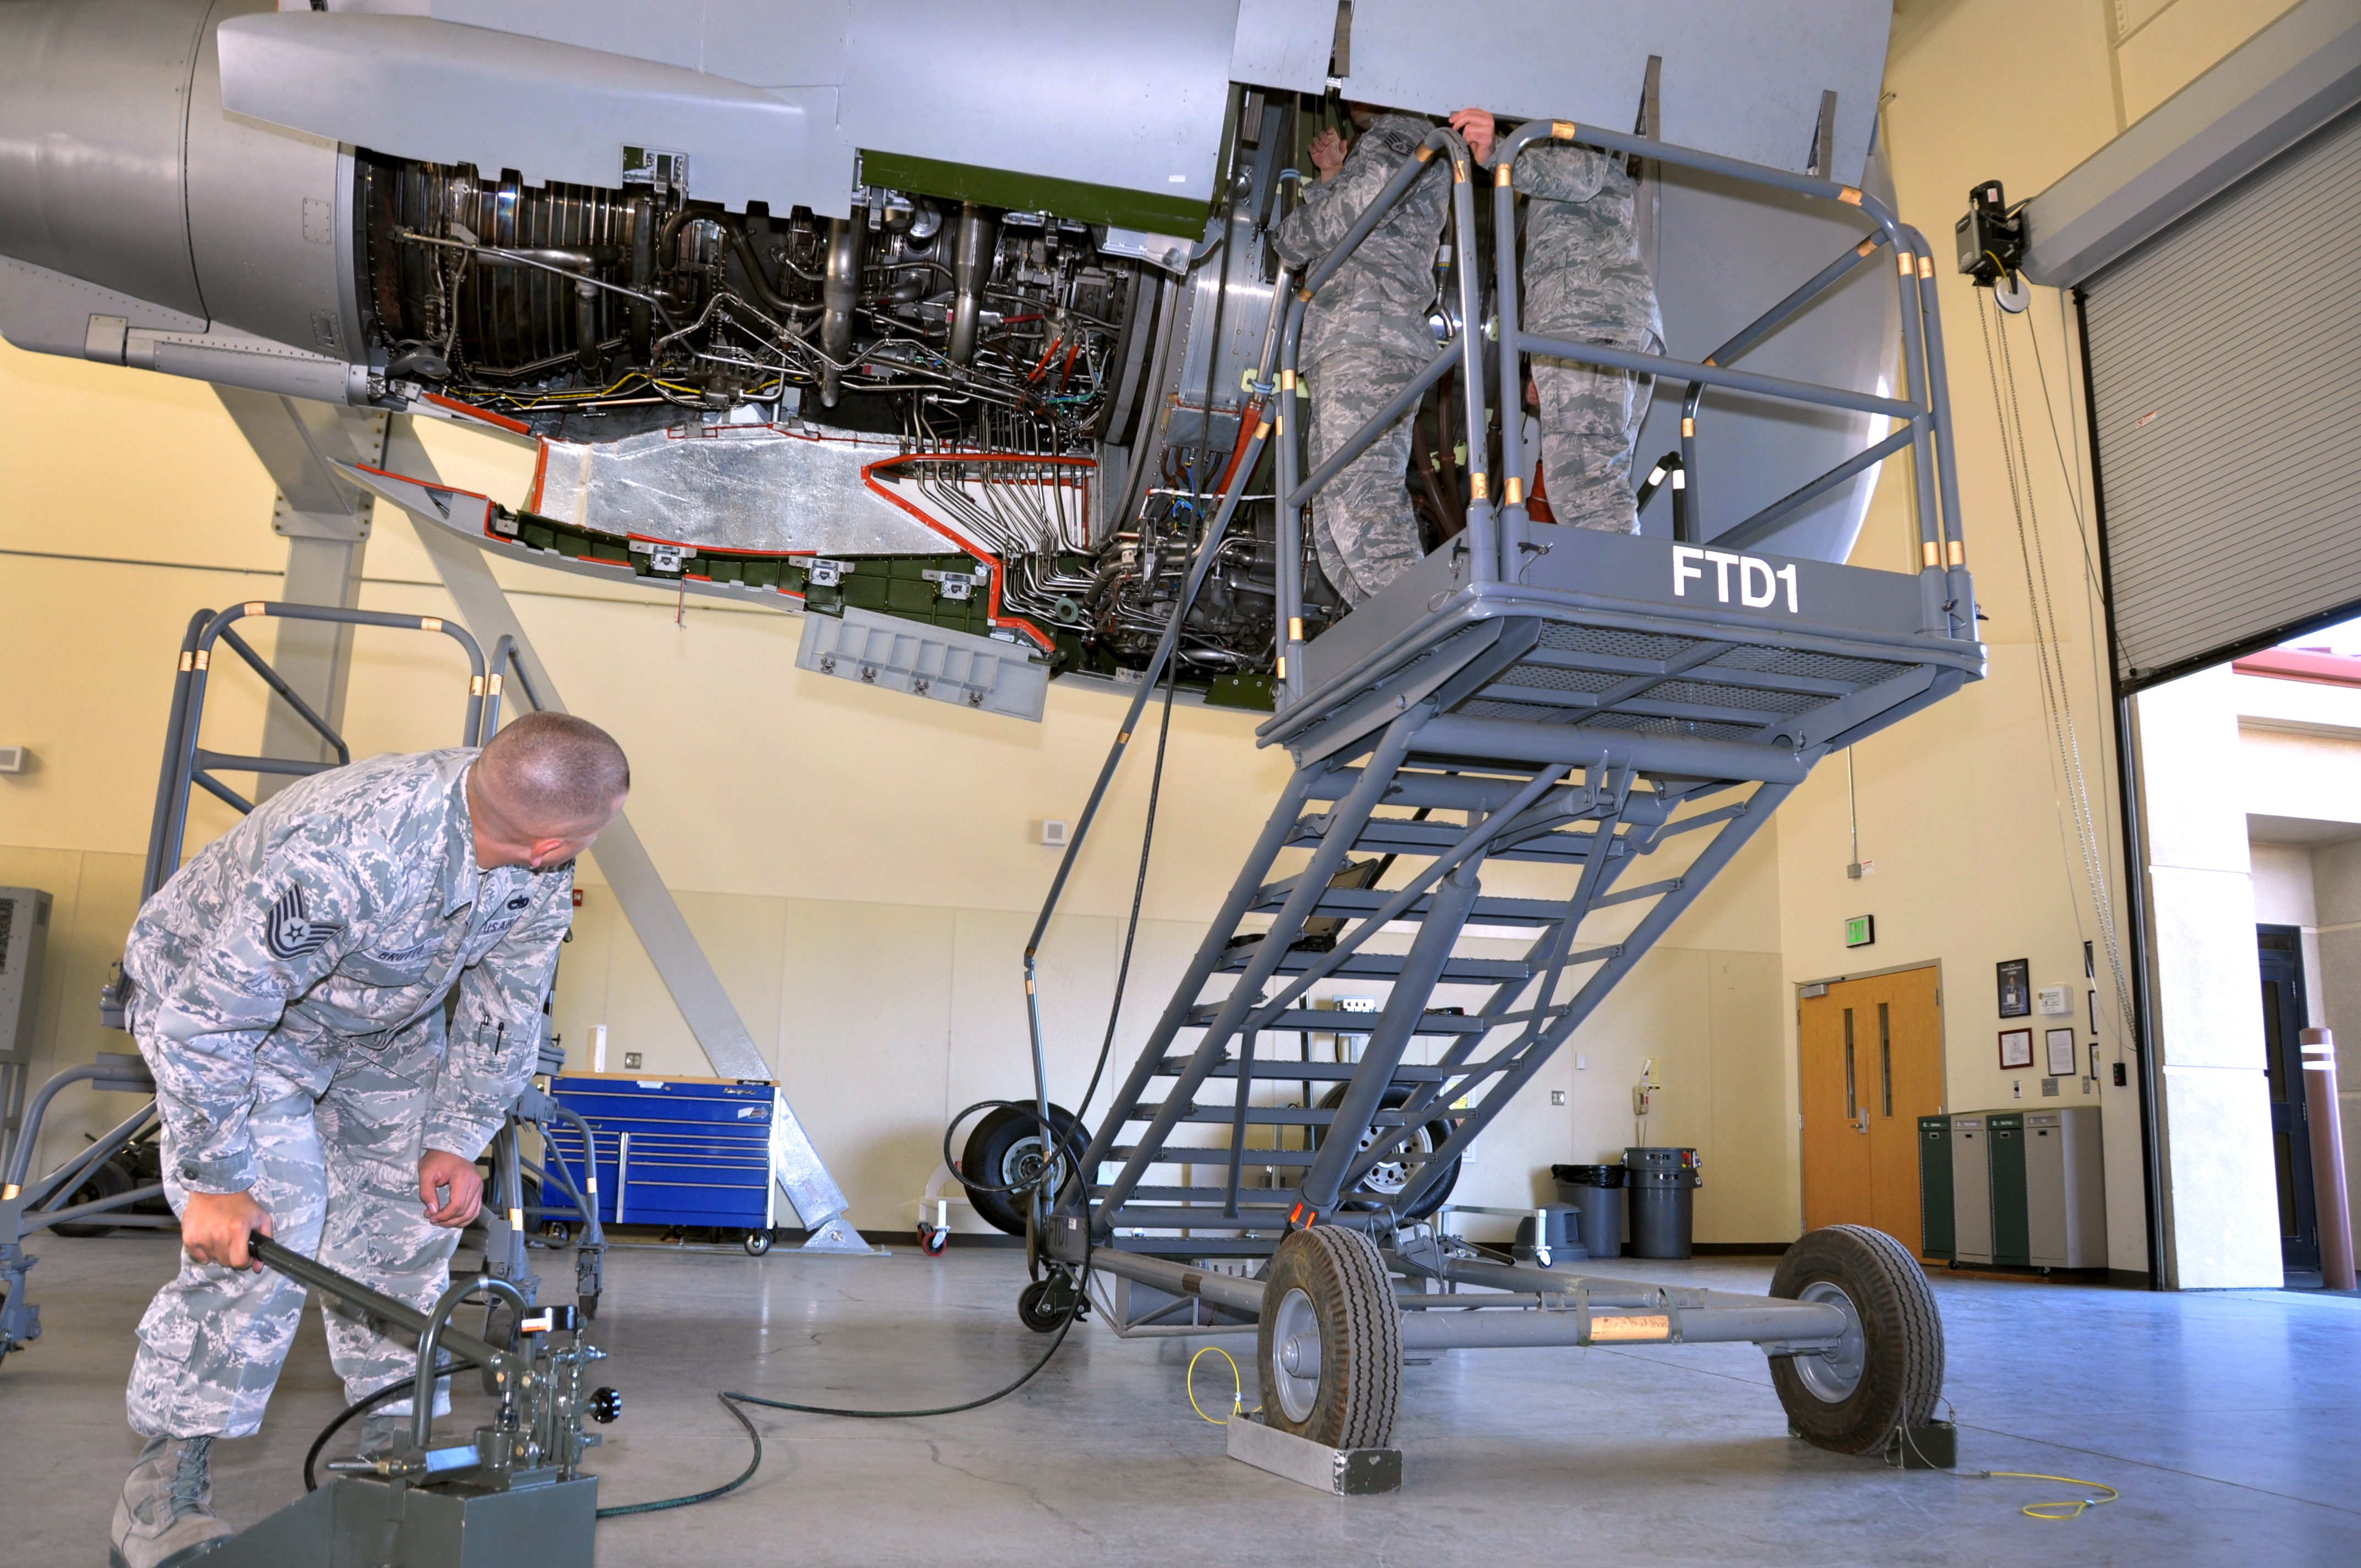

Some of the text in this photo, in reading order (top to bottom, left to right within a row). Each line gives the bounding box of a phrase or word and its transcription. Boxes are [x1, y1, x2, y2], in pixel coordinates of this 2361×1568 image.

[1673, 545, 1798, 613] FTD1
[483, 922, 498, 933] US
[1849, 919, 1865, 943] EXIT
